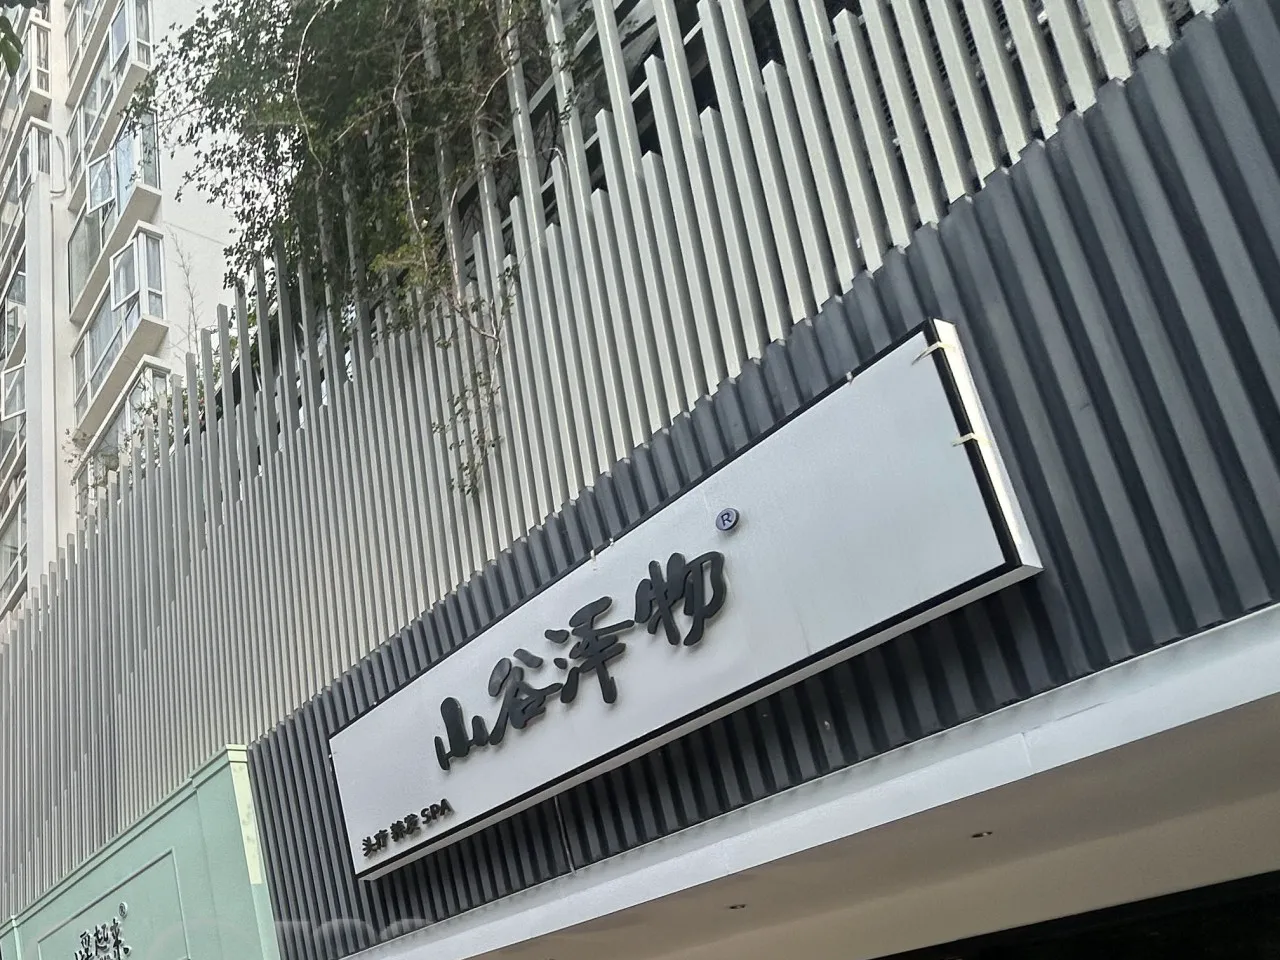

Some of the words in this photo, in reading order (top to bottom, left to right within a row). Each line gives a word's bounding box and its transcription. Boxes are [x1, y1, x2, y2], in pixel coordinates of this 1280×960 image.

[434, 551, 727, 770] 山谷泽物
[420, 798, 455, 826] SPA
